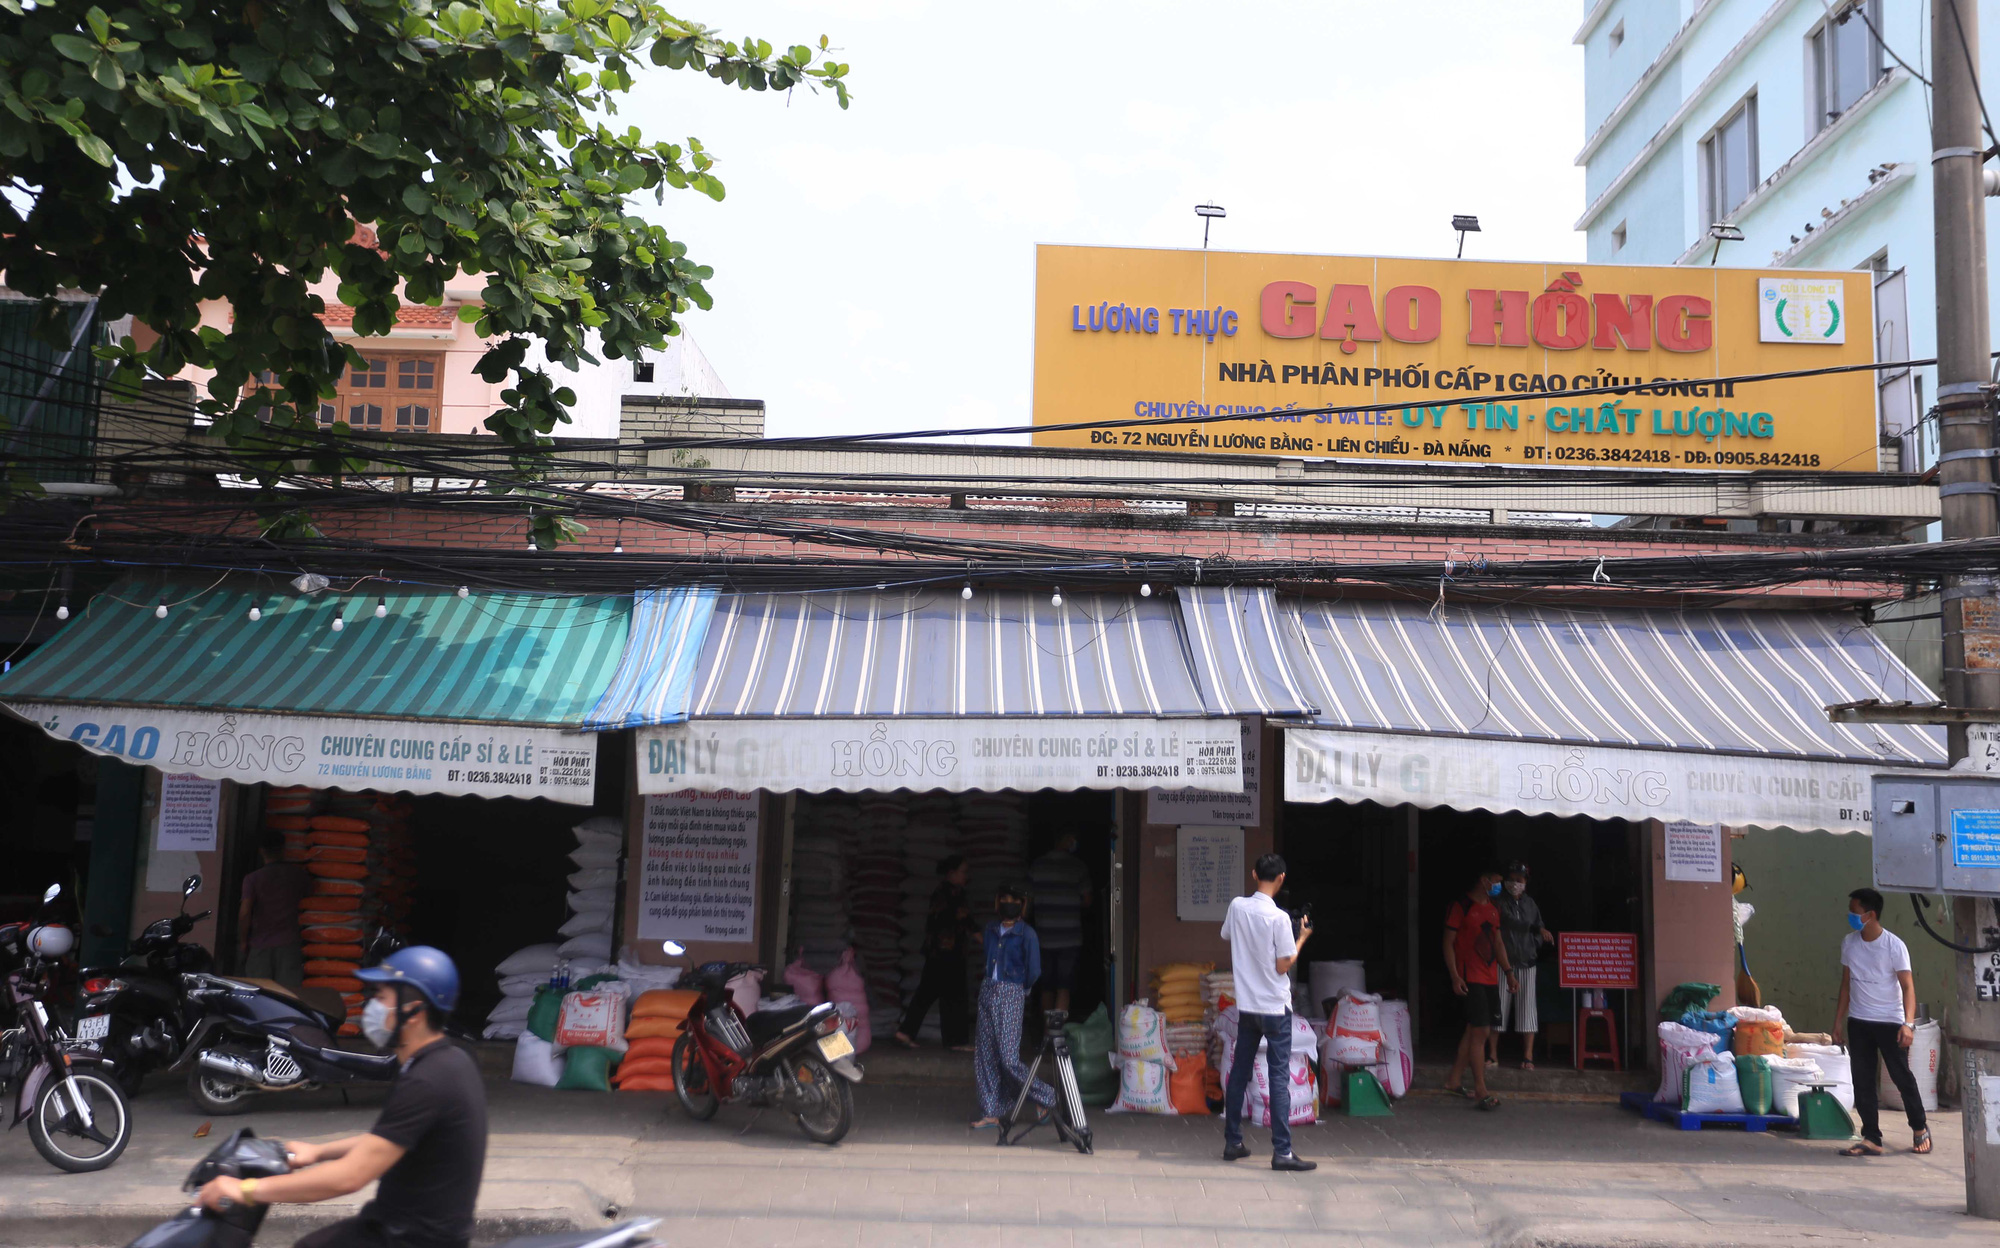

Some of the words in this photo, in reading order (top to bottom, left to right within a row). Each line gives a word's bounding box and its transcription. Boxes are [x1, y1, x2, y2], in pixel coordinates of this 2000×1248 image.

[1801, 285, 1825, 294] LONG
[1072, 301, 1160, 334] LƯƠNG
[1168, 305, 1239, 343] THỰC
[1260, 281, 1442, 355] GẠO
[1466, 271, 1713, 353] HỒNG
[1219, 359, 1276, 383] NHÀ
[1282, 362, 1359, 386] PHÂN
[1364, 363, 1430, 389] PHỐI
[1434, 365, 1492, 391] CẤP
[1495, 374, 1505, 392] I
[1635, 377, 1709, 398] LONG
[1134, 400, 1210, 419] CHUYÊN
[1401, 400, 1449, 428] UY
[1460, 401, 1519, 430] TÍN
[1545, 399, 1642, 434] CHẤT
[1652, 405, 1775, 443] LƯỢNG
[1091, 430, 1118, 445] ĐC:
[1122, 431, 1142, 445] 72
[1146, 429, 1210, 448] NGUYỄN
[1213, 433, 1266, 449] LƯƠNG
[1270, 432, 1313, 450] BẰNG
[1327, 436, 1360, 452] LIÊN
[1364, 435, 1410, 455] CHIỂU
[1423, 440, 1445, 456] ĐÀ
[1448, 439, 1492, 458] NẴNG
[1555, 446, 1671, 463] 0236.3842418
[1714, 452, 1820, 467] 0905.842418
[170, 715, 305, 773] HỒNG
[321, 733, 387, 758] CHUYÊN
[389, 738, 435, 760] CUNG
[439, 735, 471, 762] CẤP
[476, 736, 494, 764] SỈ
[498, 744, 510, 764] &
[515, 739, 533, 765] LẺ
[648, 738, 687, 782] ĐẠI
[694, 732, 720, 774] LÝ
[831, 722, 958, 777] HỒNG
[972, 735, 1034, 758] CHUYÊN
[1038, 737, 1083, 758] CUNG
[1086, 731, 1117, 758] CẤP
[1123, 731, 1139, 758] SỈ
[1144, 738, 1155, 758] &
[1161, 731, 1179, 758] LẺ
[318, 763, 329, 775] 72
[372, 764, 404, 779] LƯƠNG
[406, 765, 432, 781] BẰNG
[467, 771, 532, 785] 0236.3842418
[1116, 765, 1179, 777] 0236.3842418
[1296, 747, 1342, 793] ĐẠI
[1352, 745, 1382, 788] LÝ
[1518, 749, 1671, 806] HỒNG
[1768, 777, 1820, 798] CUNG
[1826, 774, 1864, 801] CẤP
